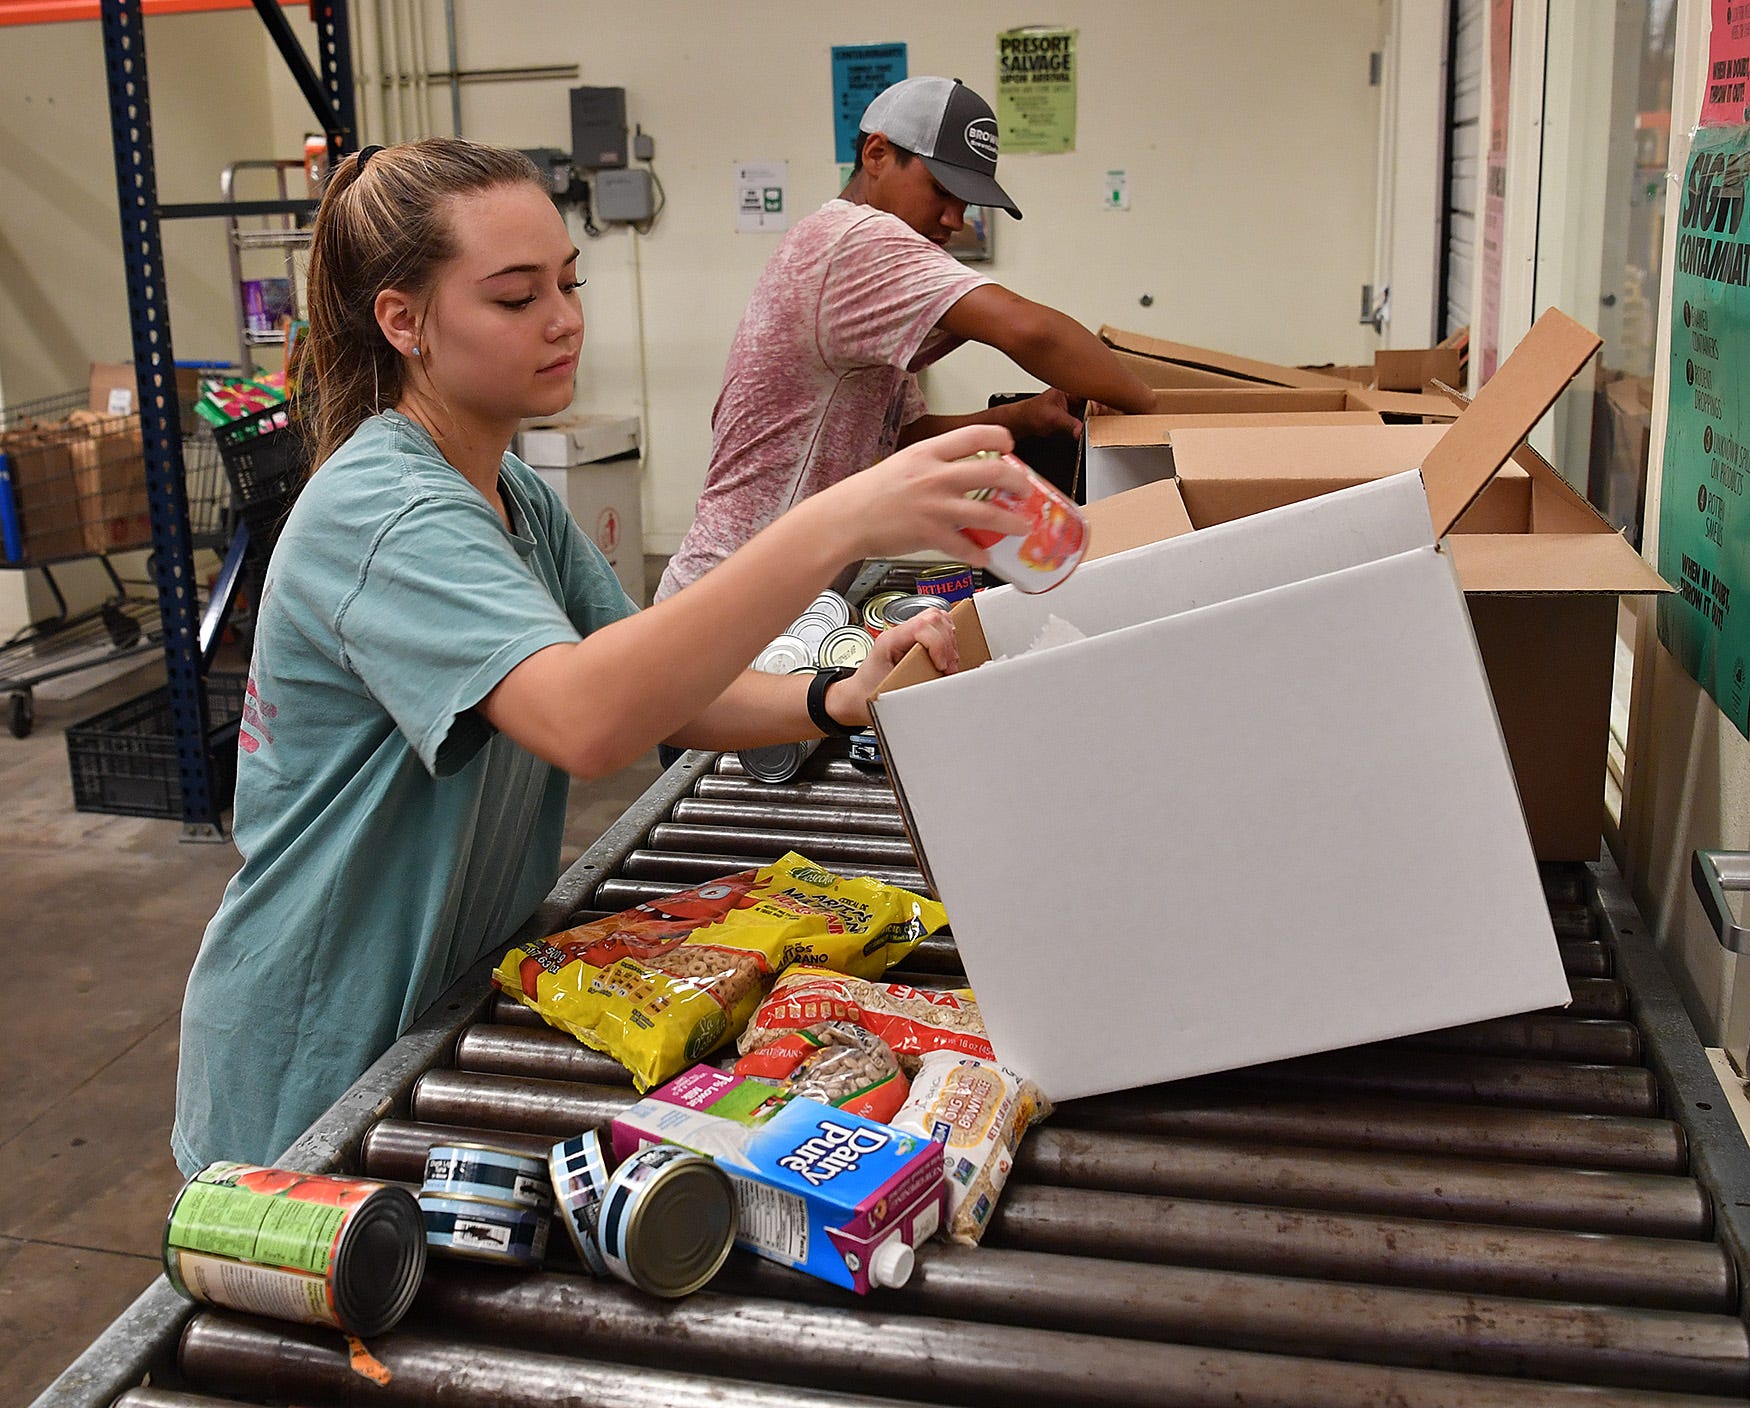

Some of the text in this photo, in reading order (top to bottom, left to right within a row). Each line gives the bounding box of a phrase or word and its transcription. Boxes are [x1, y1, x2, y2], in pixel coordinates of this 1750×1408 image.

[1001, 36, 1070, 54] PRESORT
[1001, 54, 1070, 72] SALVAGE
[1682, 553, 1701, 585] WHEN
[1702, 567, 1710, 592] IN
[1681, 577, 1702, 612] THROW
[1703, 595, 1711, 618] IT
[527, 947, 552, 968] 17.63
[713, 1073, 734, 1089] 1%
[802, 1126, 890, 1187] Dairy
